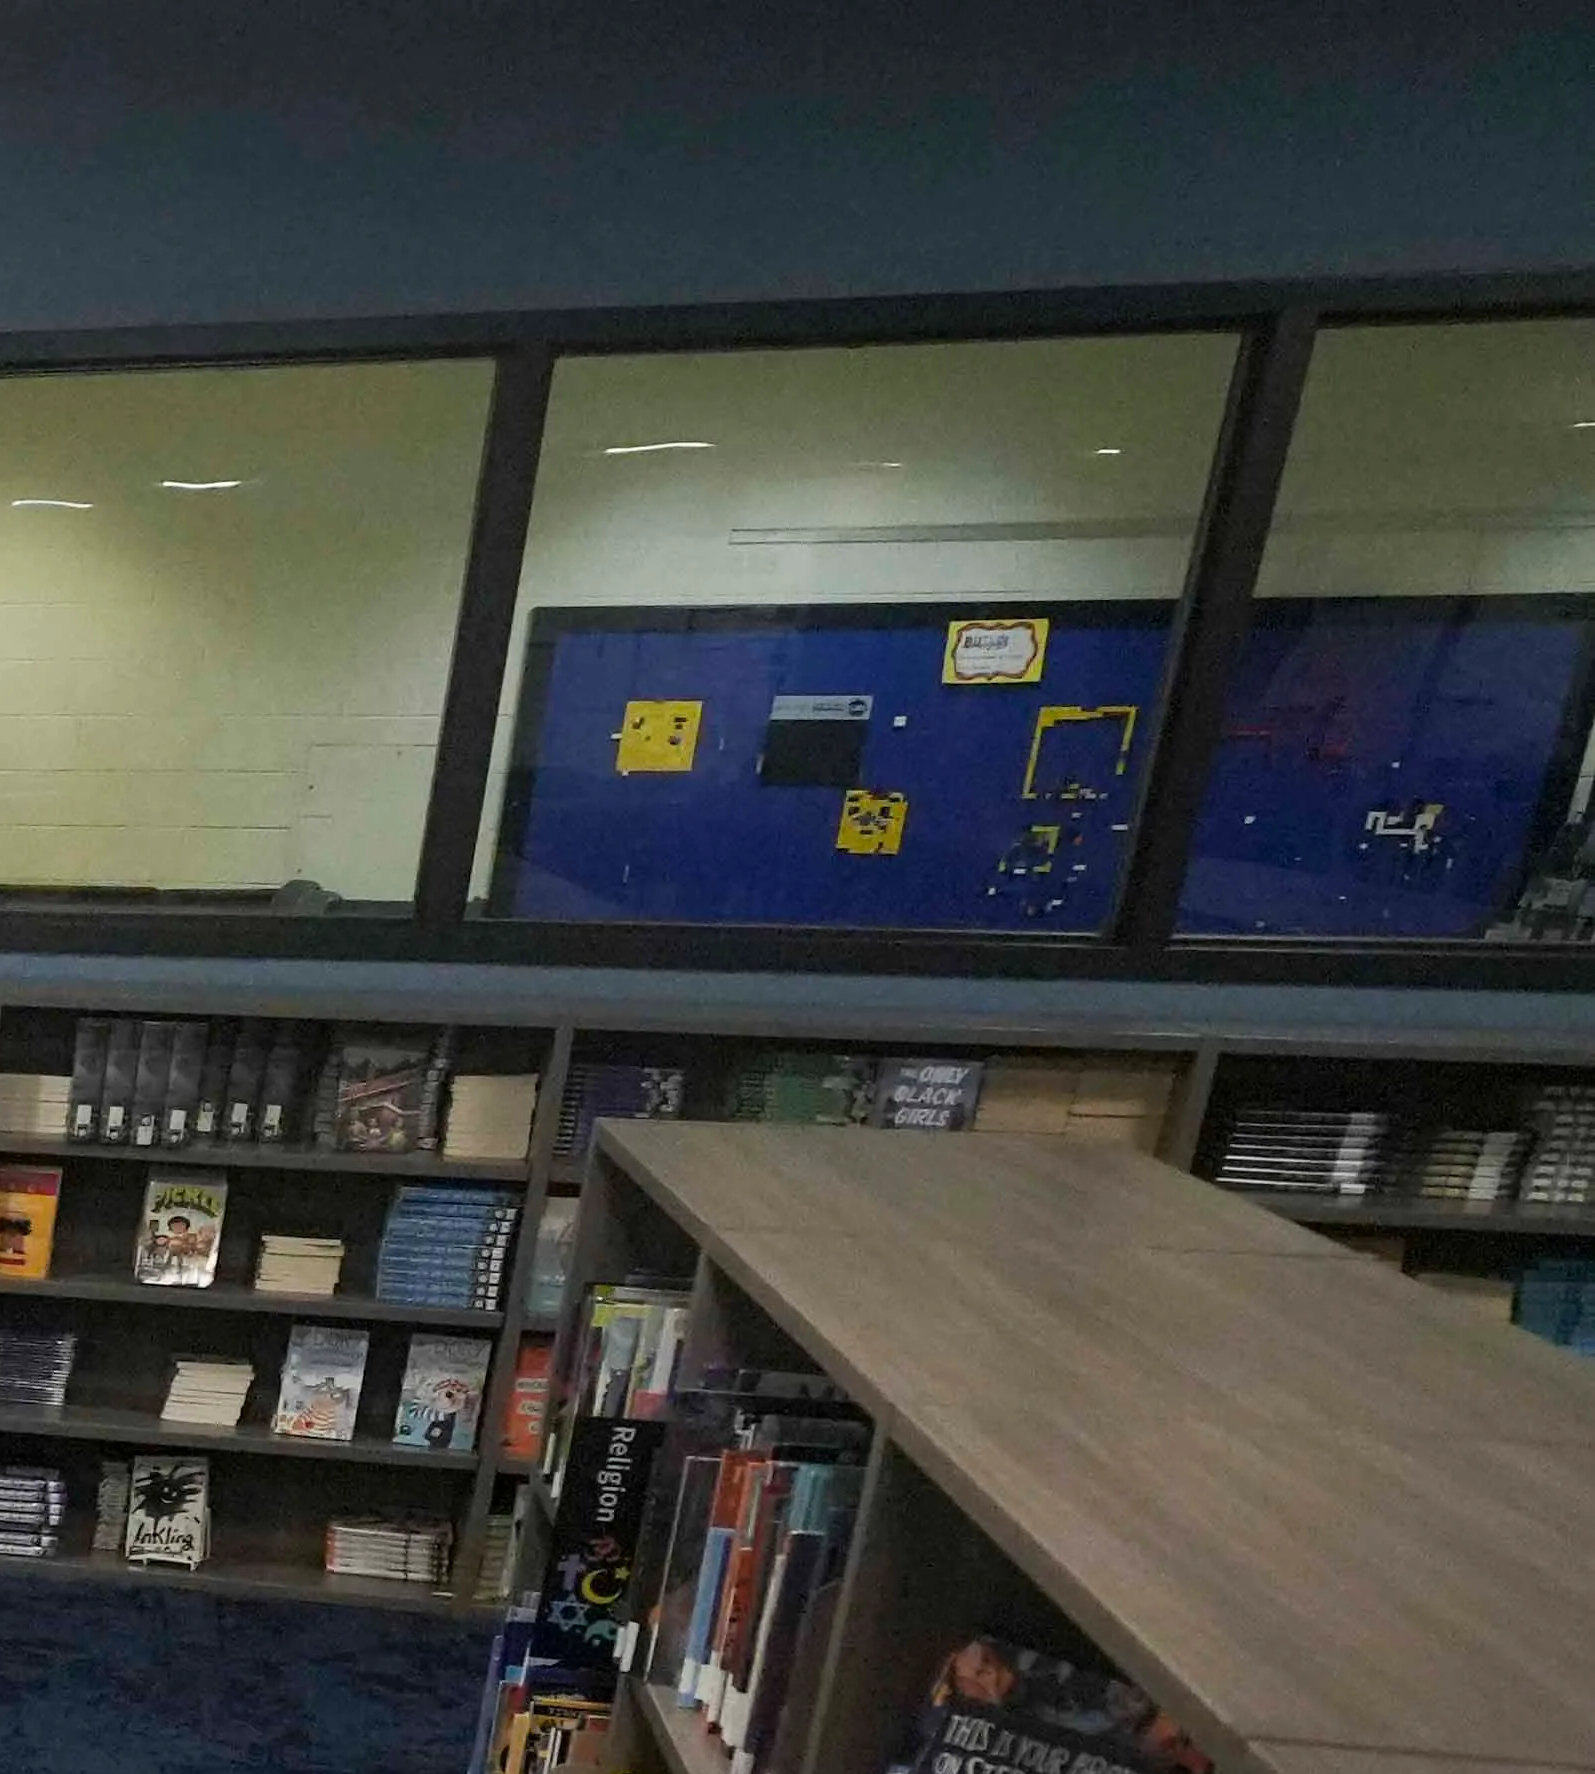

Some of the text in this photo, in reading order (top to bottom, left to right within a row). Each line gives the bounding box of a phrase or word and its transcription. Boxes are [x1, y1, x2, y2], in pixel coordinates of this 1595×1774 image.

[895, 1107, 952, 1127] GIRLS
[595, 1425, 637, 1523] Religion
[943, 1714, 995, 1752] THIS
